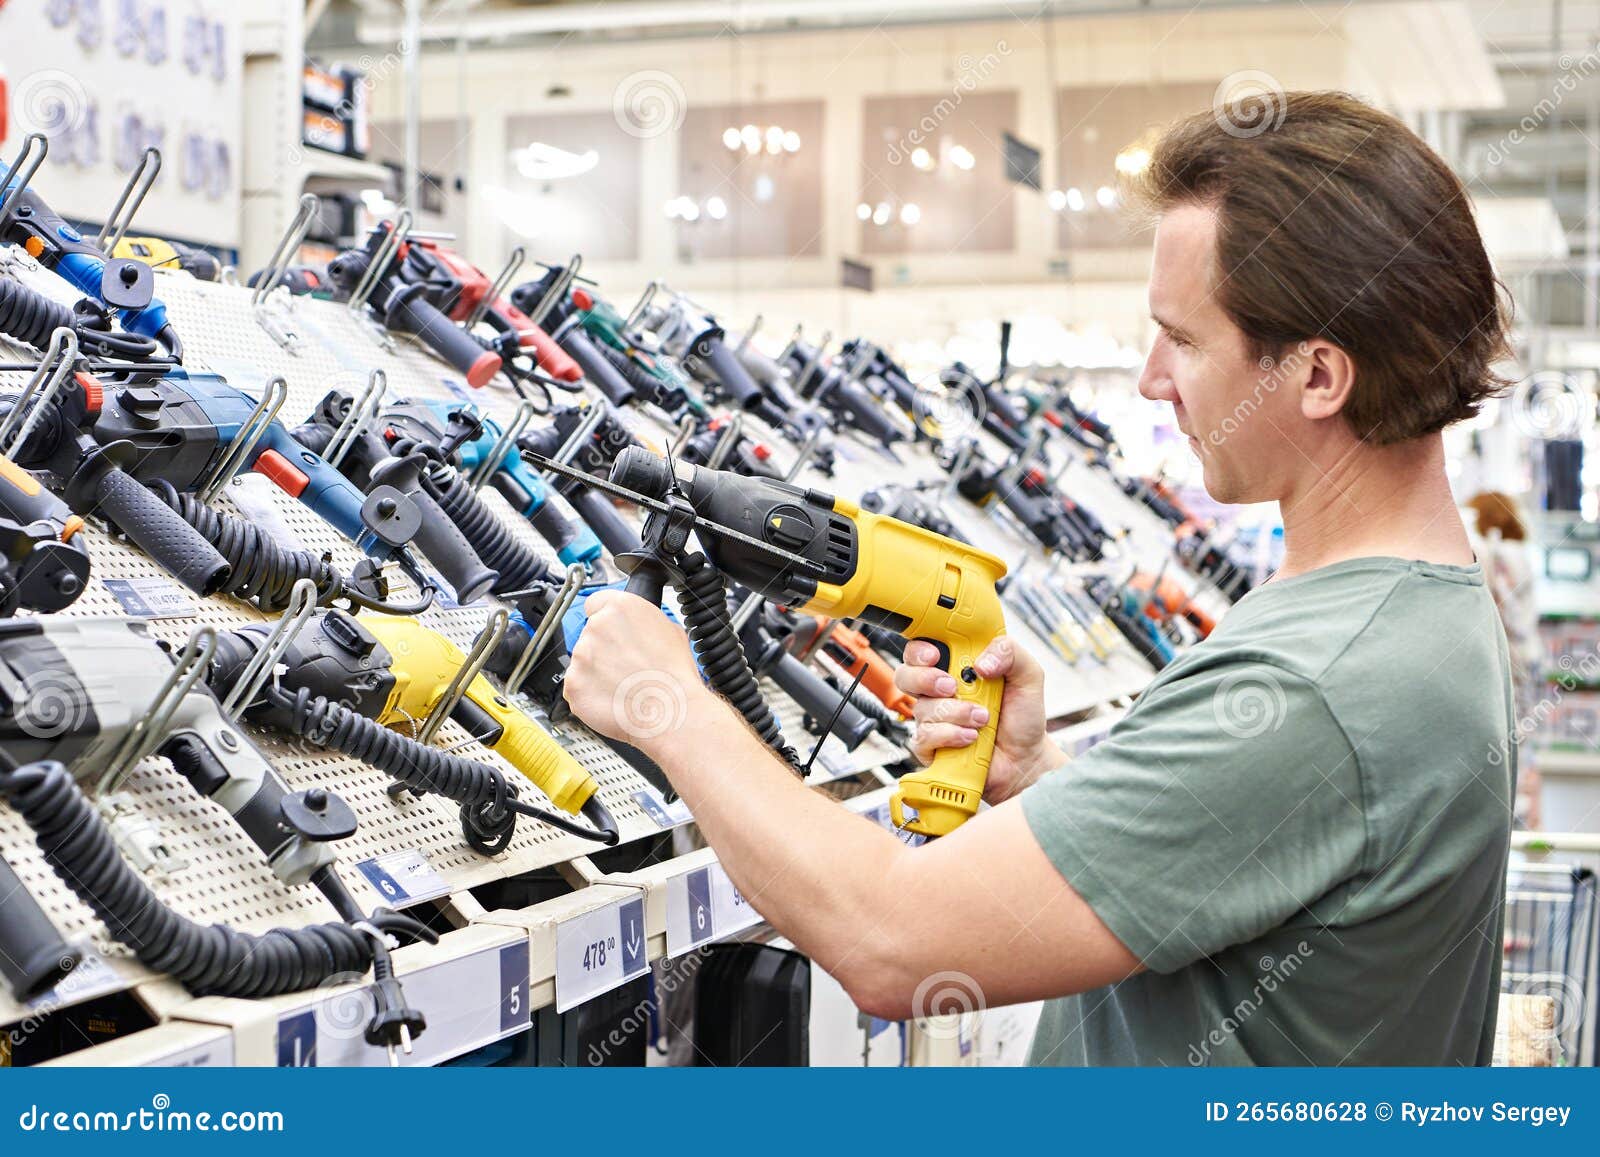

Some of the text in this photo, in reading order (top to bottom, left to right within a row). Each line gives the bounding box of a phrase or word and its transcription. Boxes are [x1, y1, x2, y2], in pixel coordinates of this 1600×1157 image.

[380, 879, 396, 896] 6
[696, 905, 706, 931] 6
[583, 940, 607, 972] 478
[511, 985, 520, 1015] 5
